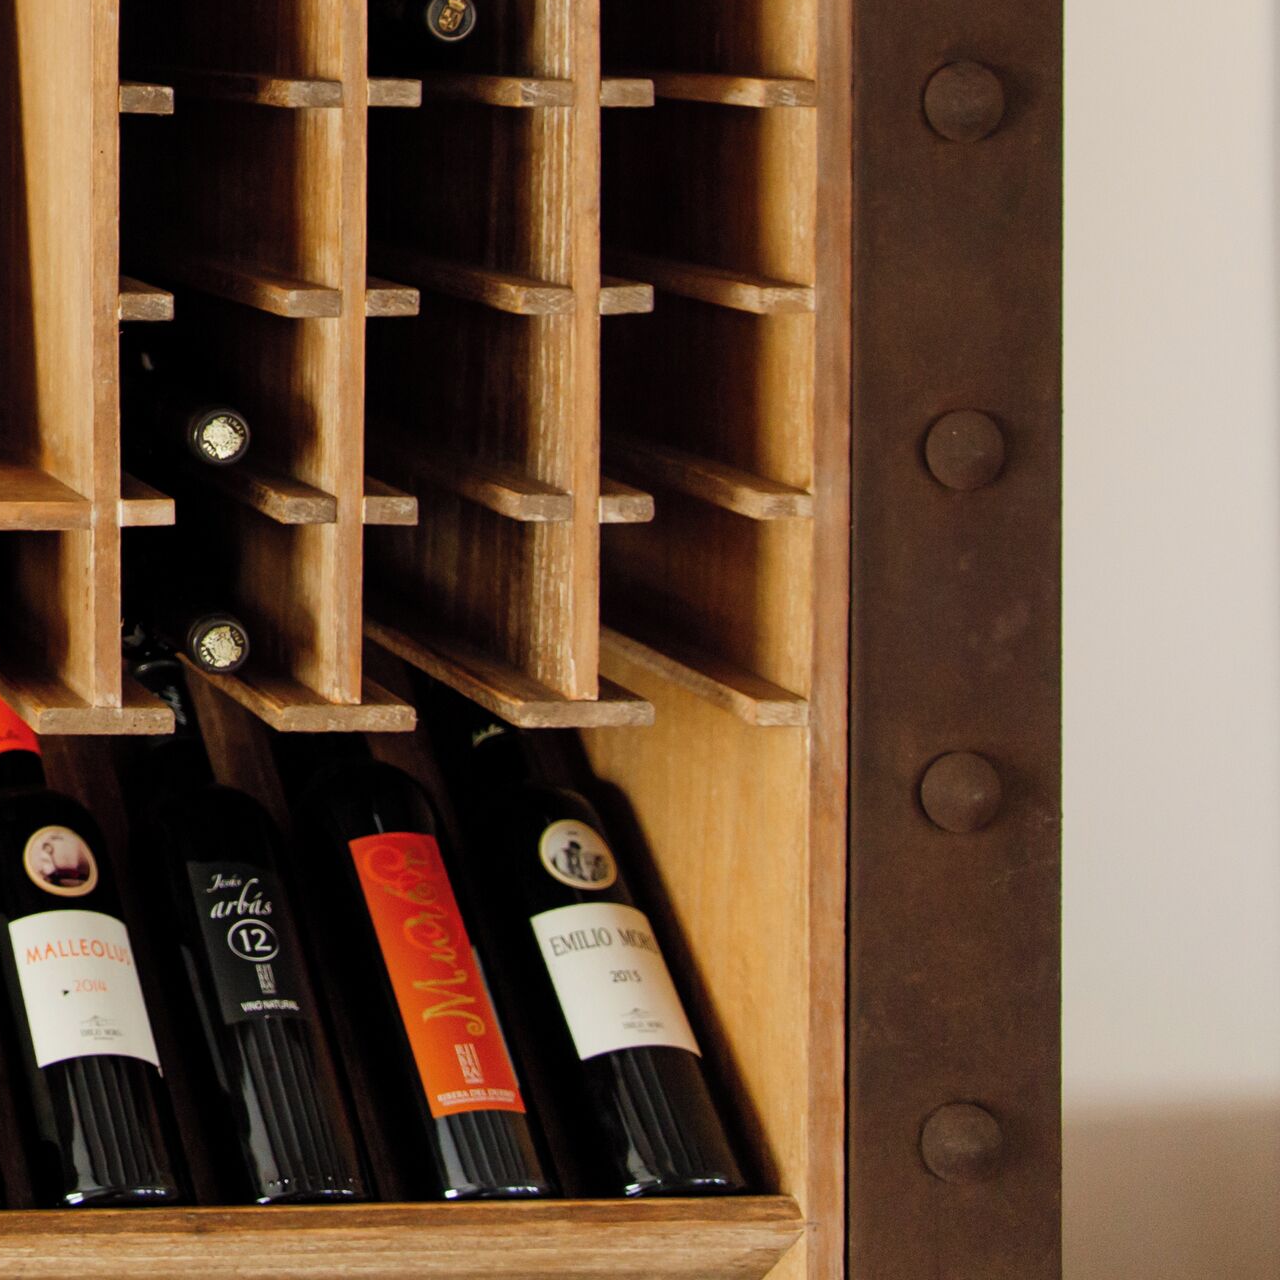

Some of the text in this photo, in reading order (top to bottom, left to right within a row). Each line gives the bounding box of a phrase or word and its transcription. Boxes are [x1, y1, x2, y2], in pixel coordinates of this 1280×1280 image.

[210, 877, 273, 919] arbás
[238, 927, 273, 953] 12
[549, 926, 614, 957] EMILIO
